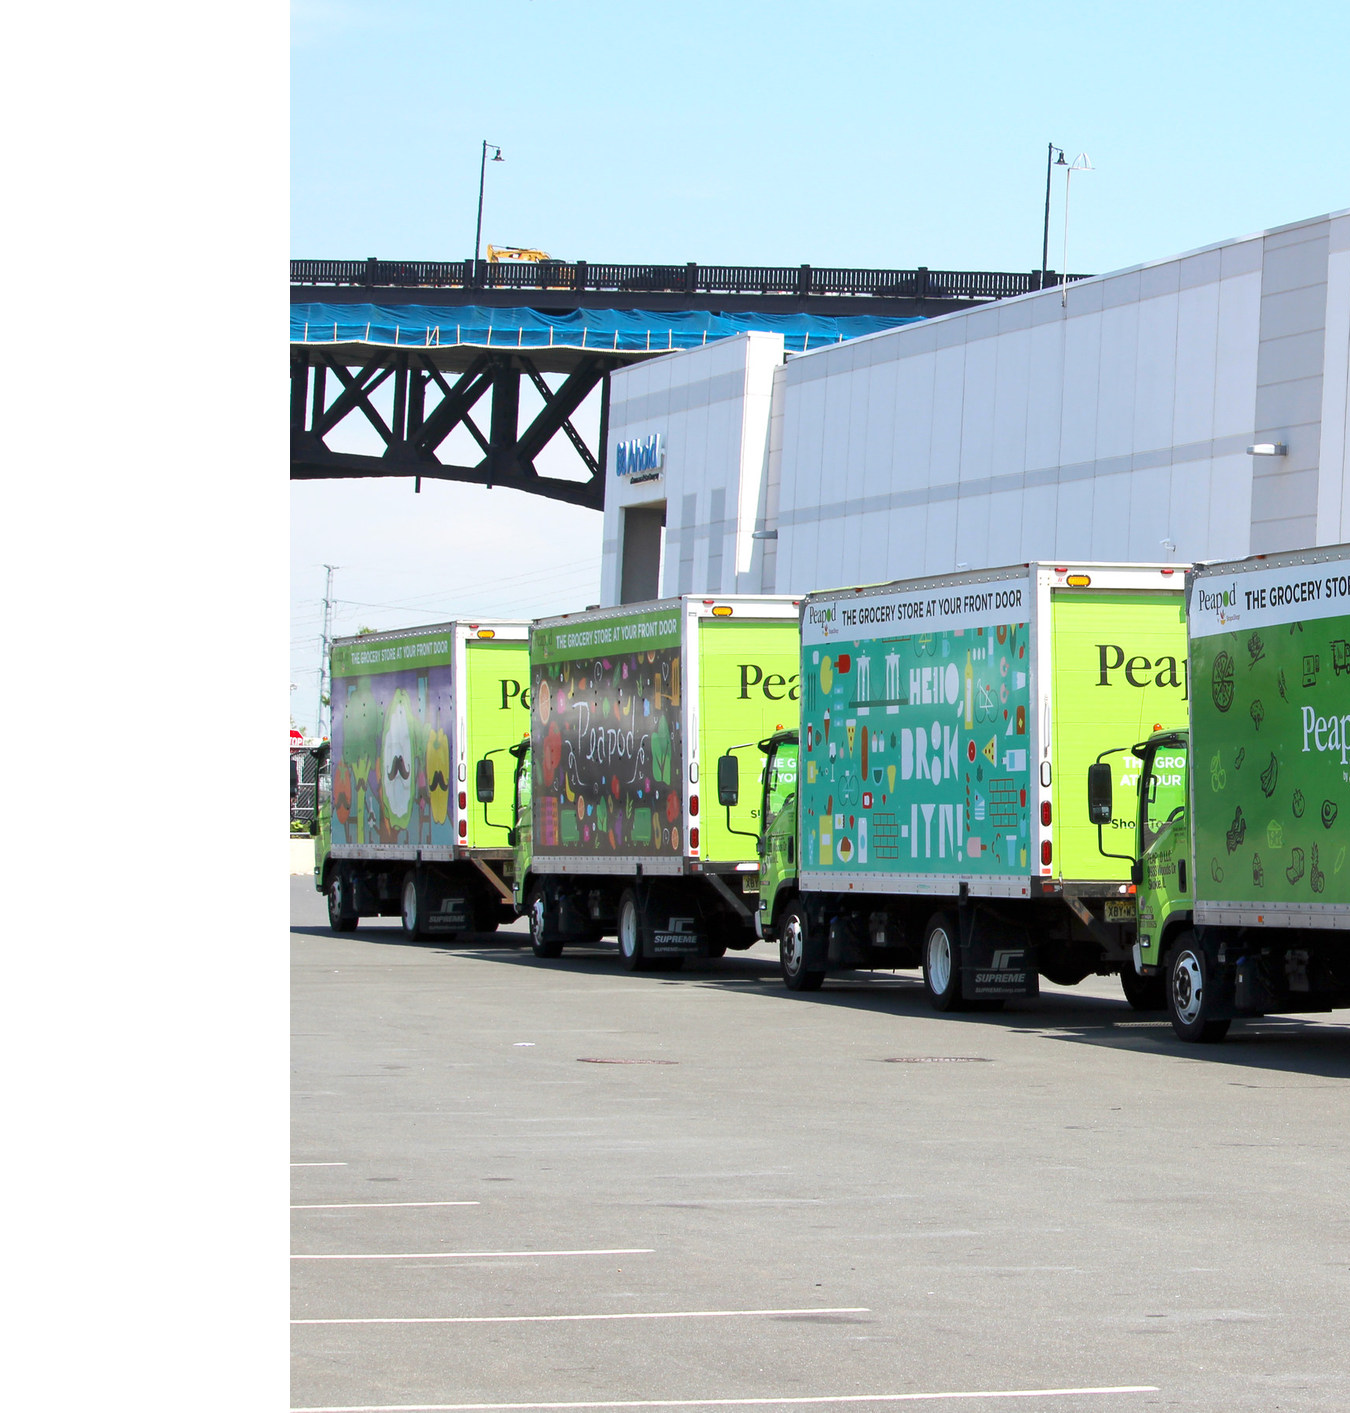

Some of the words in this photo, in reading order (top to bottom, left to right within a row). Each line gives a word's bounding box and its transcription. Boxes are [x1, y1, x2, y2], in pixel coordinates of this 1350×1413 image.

[842, 610, 857, 626] THE
[858, 605, 896, 625] GROCERY
[897, 601, 924, 621] STORE
[925, 600, 938, 617] AT
[938, 597, 963, 615] YOUR
[963, 592, 994, 613] FRONT
[995, 589, 1022, 609] DOOR
[1198, 582, 1237, 615] Peapod
[1245, 588, 1267, 610] THE
[1269, 580, 1322, 607] GROCERY
[809, 602, 837, 628] Peapod
[556, 635, 567, 649] THE
[567, 631, 594, 648] GROCERY
[594, 628, 612, 644] STORE
[613, 627, 622, 641] AT
[621, 624, 638, 640] YOUR
[637, 621, 658, 638] FRONT
[659, 619, 677, 635] DOOR
[351, 653, 360, 665] THE
[360, 650, 381, 664] GROCERY
[381, 648, 396, 662] STORE
[395, 647, 403, 659] AT
[402, 645, 416, 659] YOUR
[416, 642, 433, 657] FRONT
[433, 641, 449, 654] DOOR
[571, 695, 637, 766] Peapod
[1120, 774, 1139, 786] AT
[1150, 774, 1182, 786] OUR
[654, 935, 698, 943] SUPREME
[975, 973, 1026, 983] SUPREME
